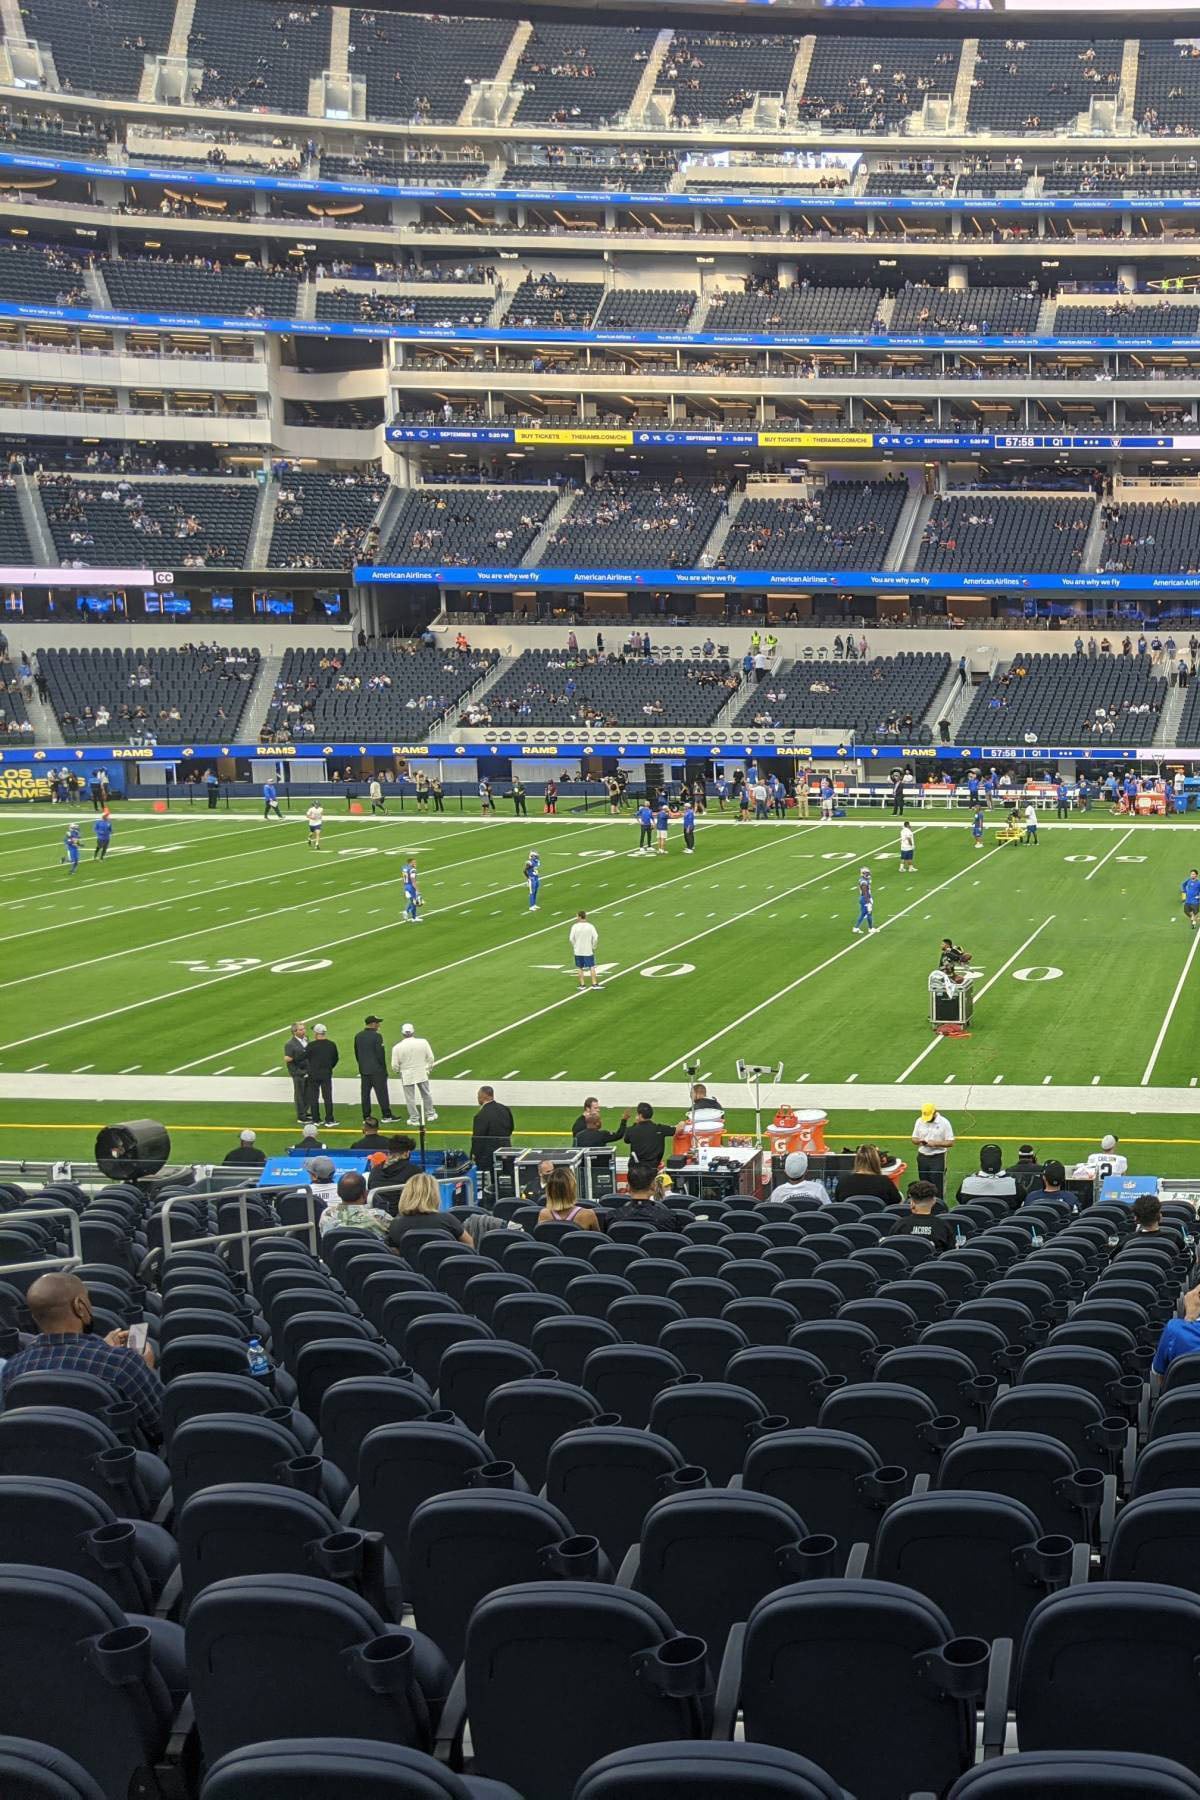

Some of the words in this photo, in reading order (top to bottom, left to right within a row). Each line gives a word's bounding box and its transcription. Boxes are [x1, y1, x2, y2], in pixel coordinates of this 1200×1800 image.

[1005, 437, 1034, 446] 57:58
[1052, 438, 1063, 446] Q1
[157, 573, 173, 583] CC
[477, 572, 490, 580] You
[504, 572, 518, 581] why
[701, 574, 715, 583] why
[895, 576, 909, 585] why
[1086, 579, 1100, 587] why
[113, 749, 153, 758] RAMS
[256, 746, 296, 756] RAMS
[392, 746, 429, 755] RAMS
[522, 746, 558, 755] RAMS
[650, 746, 685, 755] RAMS
[777, 747, 811, 756] RAMS
[902, 748, 936, 757] RAMS
[991, 749, 1016, 758] 57:58
[799, 1128, 812, 1142] G
[774, 1139, 787, 1153] G
[1100, 1163, 1113, 1180] 2
[910, 1225, 932, 1235] JACOBS
